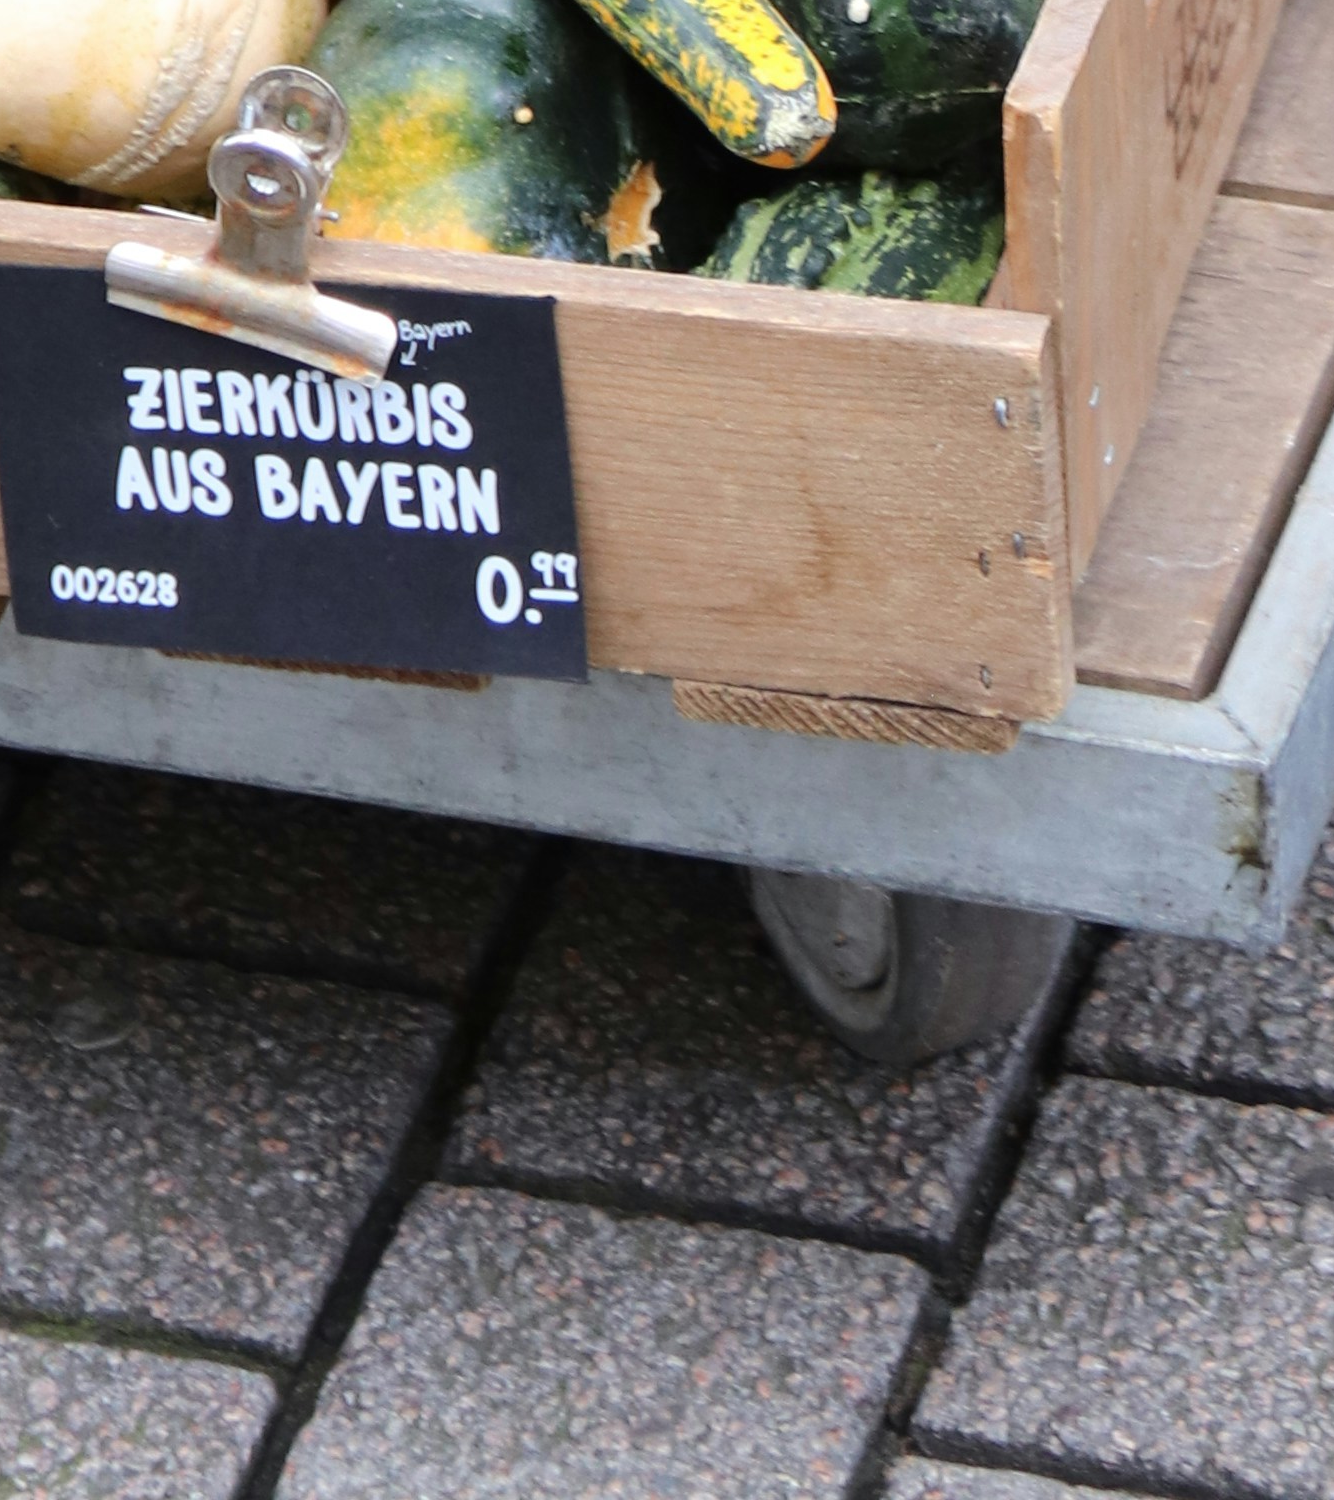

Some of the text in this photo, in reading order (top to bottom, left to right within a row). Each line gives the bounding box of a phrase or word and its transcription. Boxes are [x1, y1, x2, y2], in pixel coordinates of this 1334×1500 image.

[397, 317, 473, 352] Bayern
[123, 365, 474, 451] ZIERKÜRBIS
[115, 444, 501, 536] AUS BAYERN
[50, 563, 179, 608] 002628
